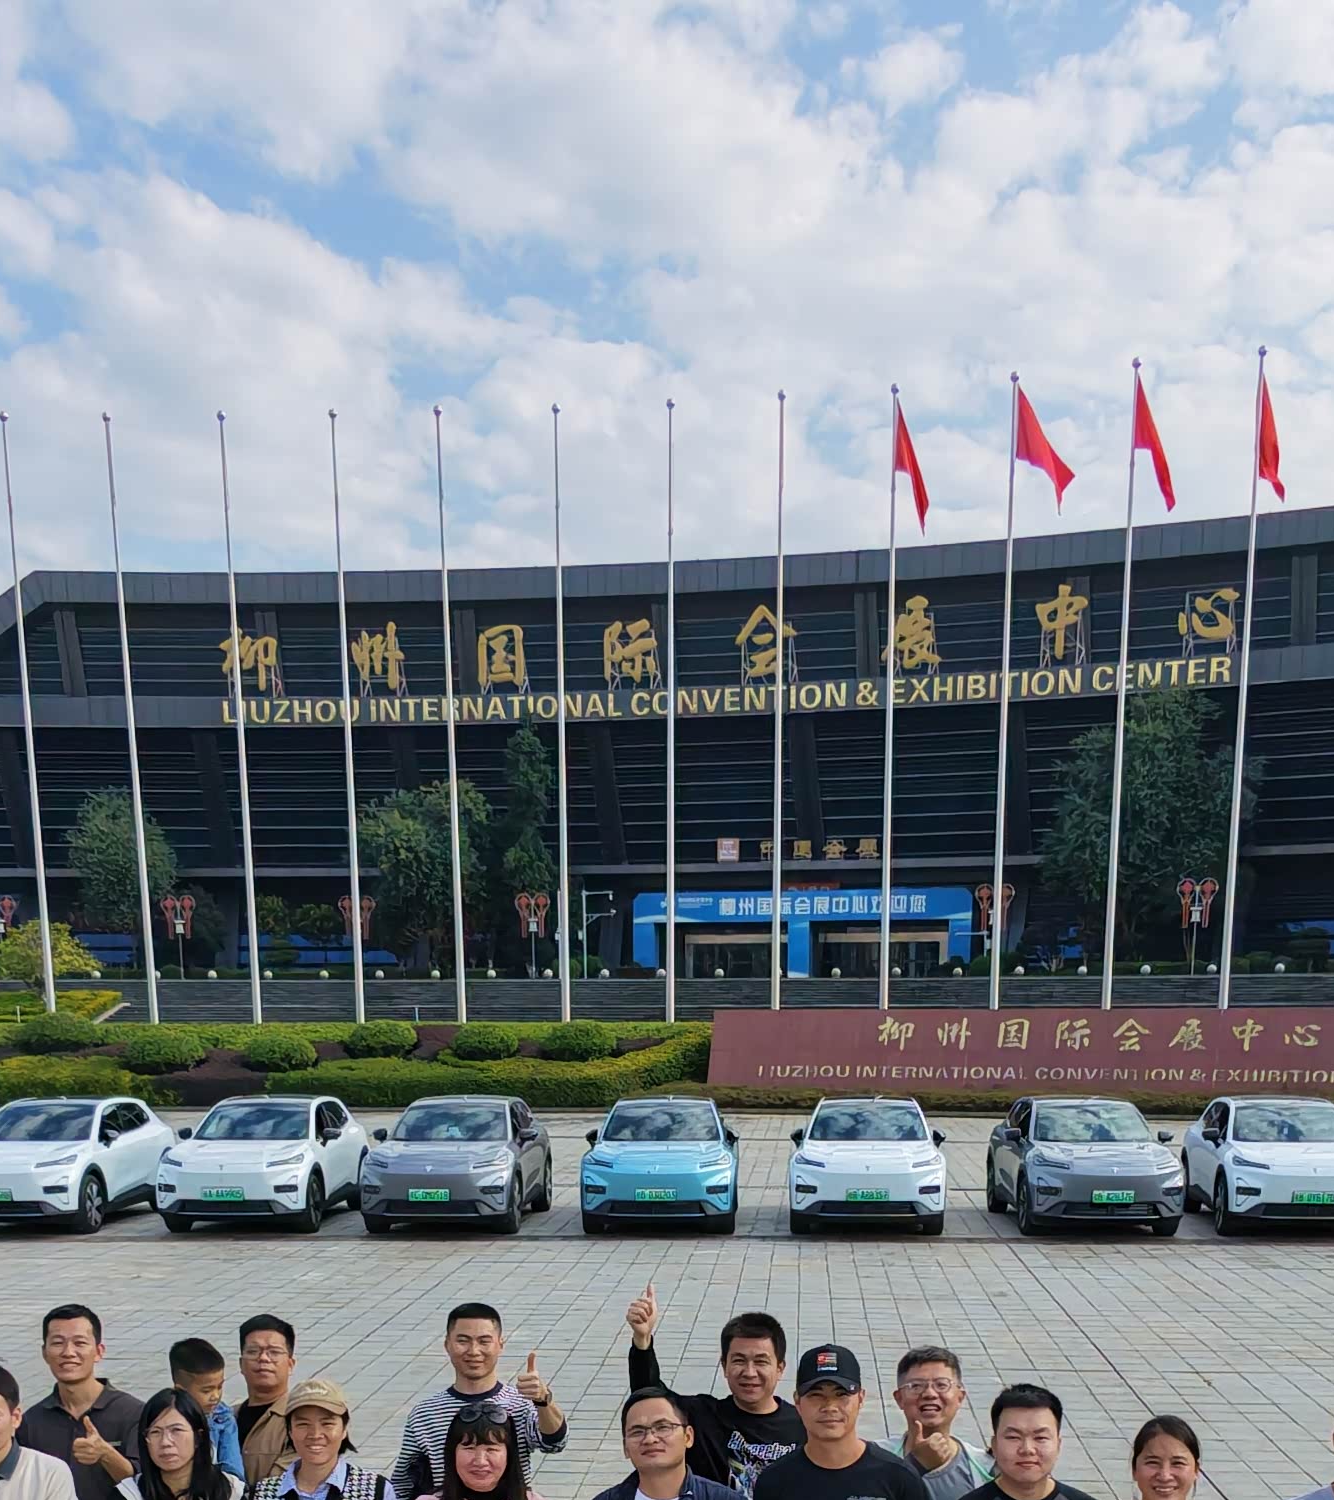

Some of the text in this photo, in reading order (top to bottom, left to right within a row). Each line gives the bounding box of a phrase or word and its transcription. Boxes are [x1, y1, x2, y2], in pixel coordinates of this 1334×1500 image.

[222, 656, 1233, 724] LIUZHOU INTERNATIONAL CONVENTION & EXHIBITION CENTER
[877, 1015, 1323, 1053] 柳州国际会展中心
[1189, 1068, 1208, 1083] &
